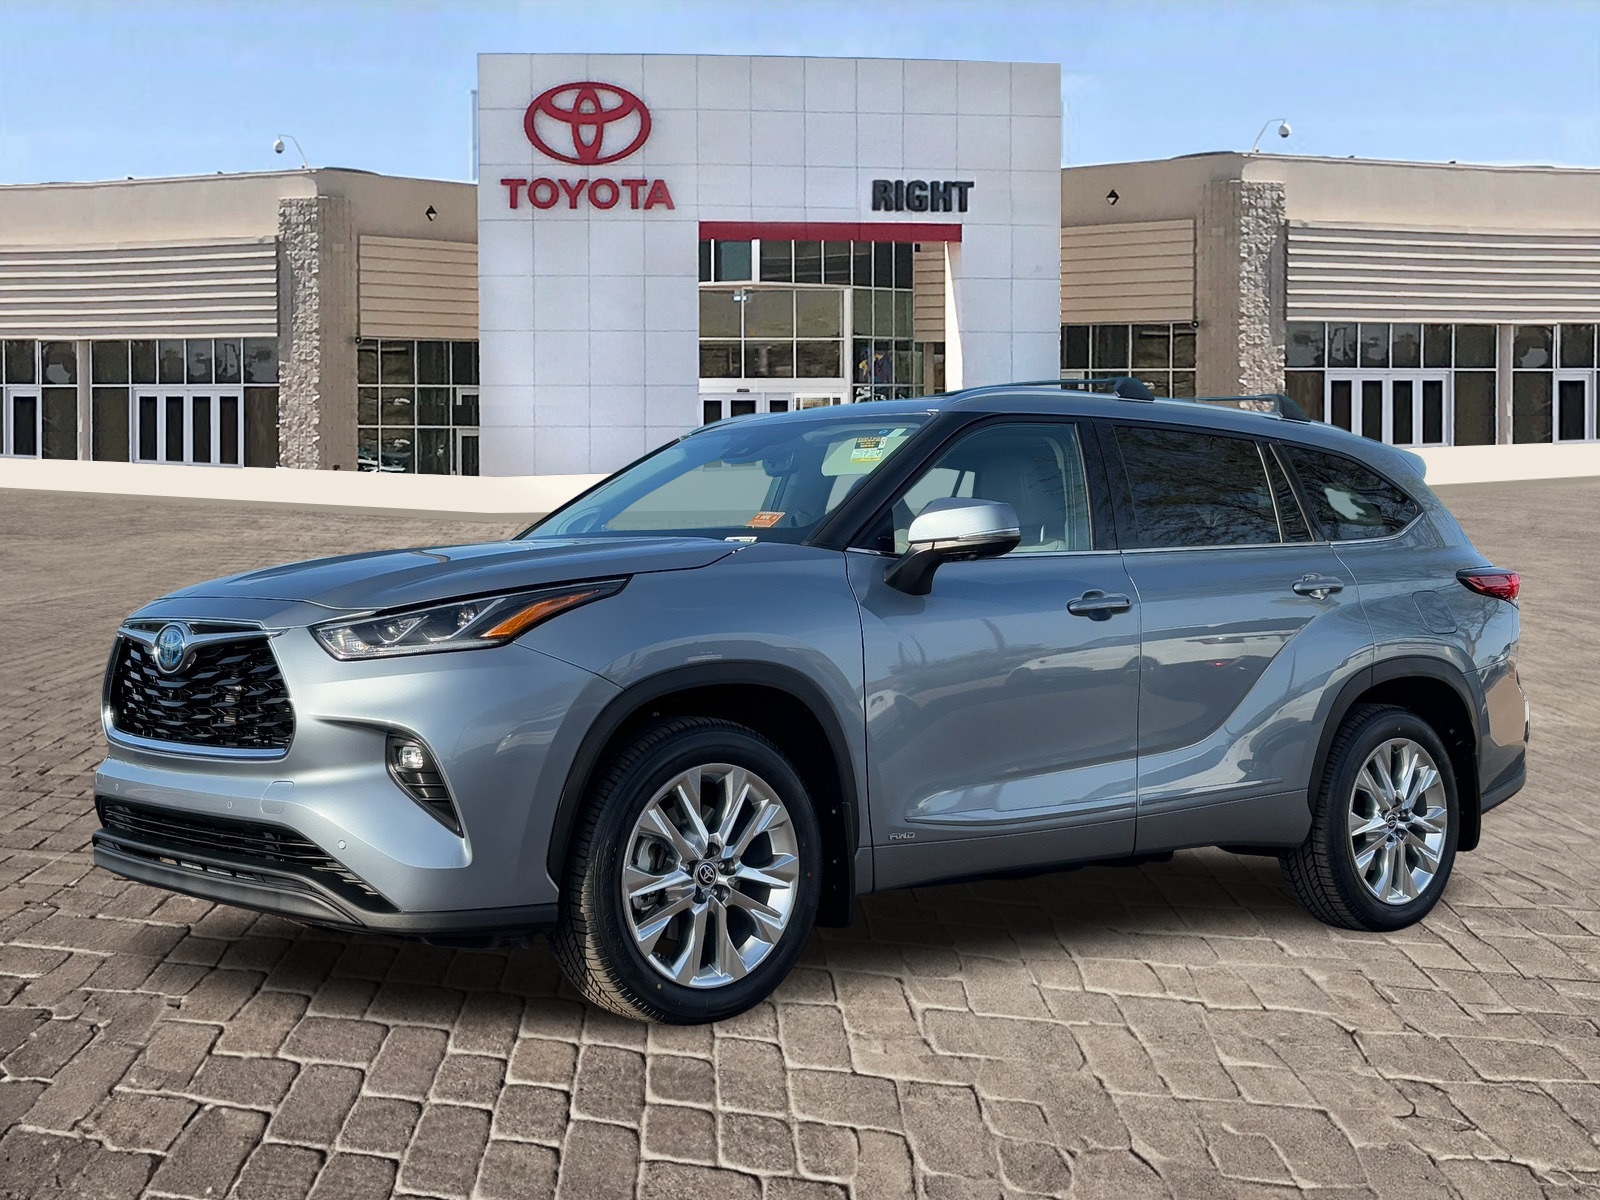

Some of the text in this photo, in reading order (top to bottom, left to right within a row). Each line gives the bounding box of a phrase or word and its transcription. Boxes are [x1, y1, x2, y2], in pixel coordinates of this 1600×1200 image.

[500, 178, 675, 209] TOYOTA
[872, 180, 975, 212] RIGHT
[889, 832, 916, 840] AWD
